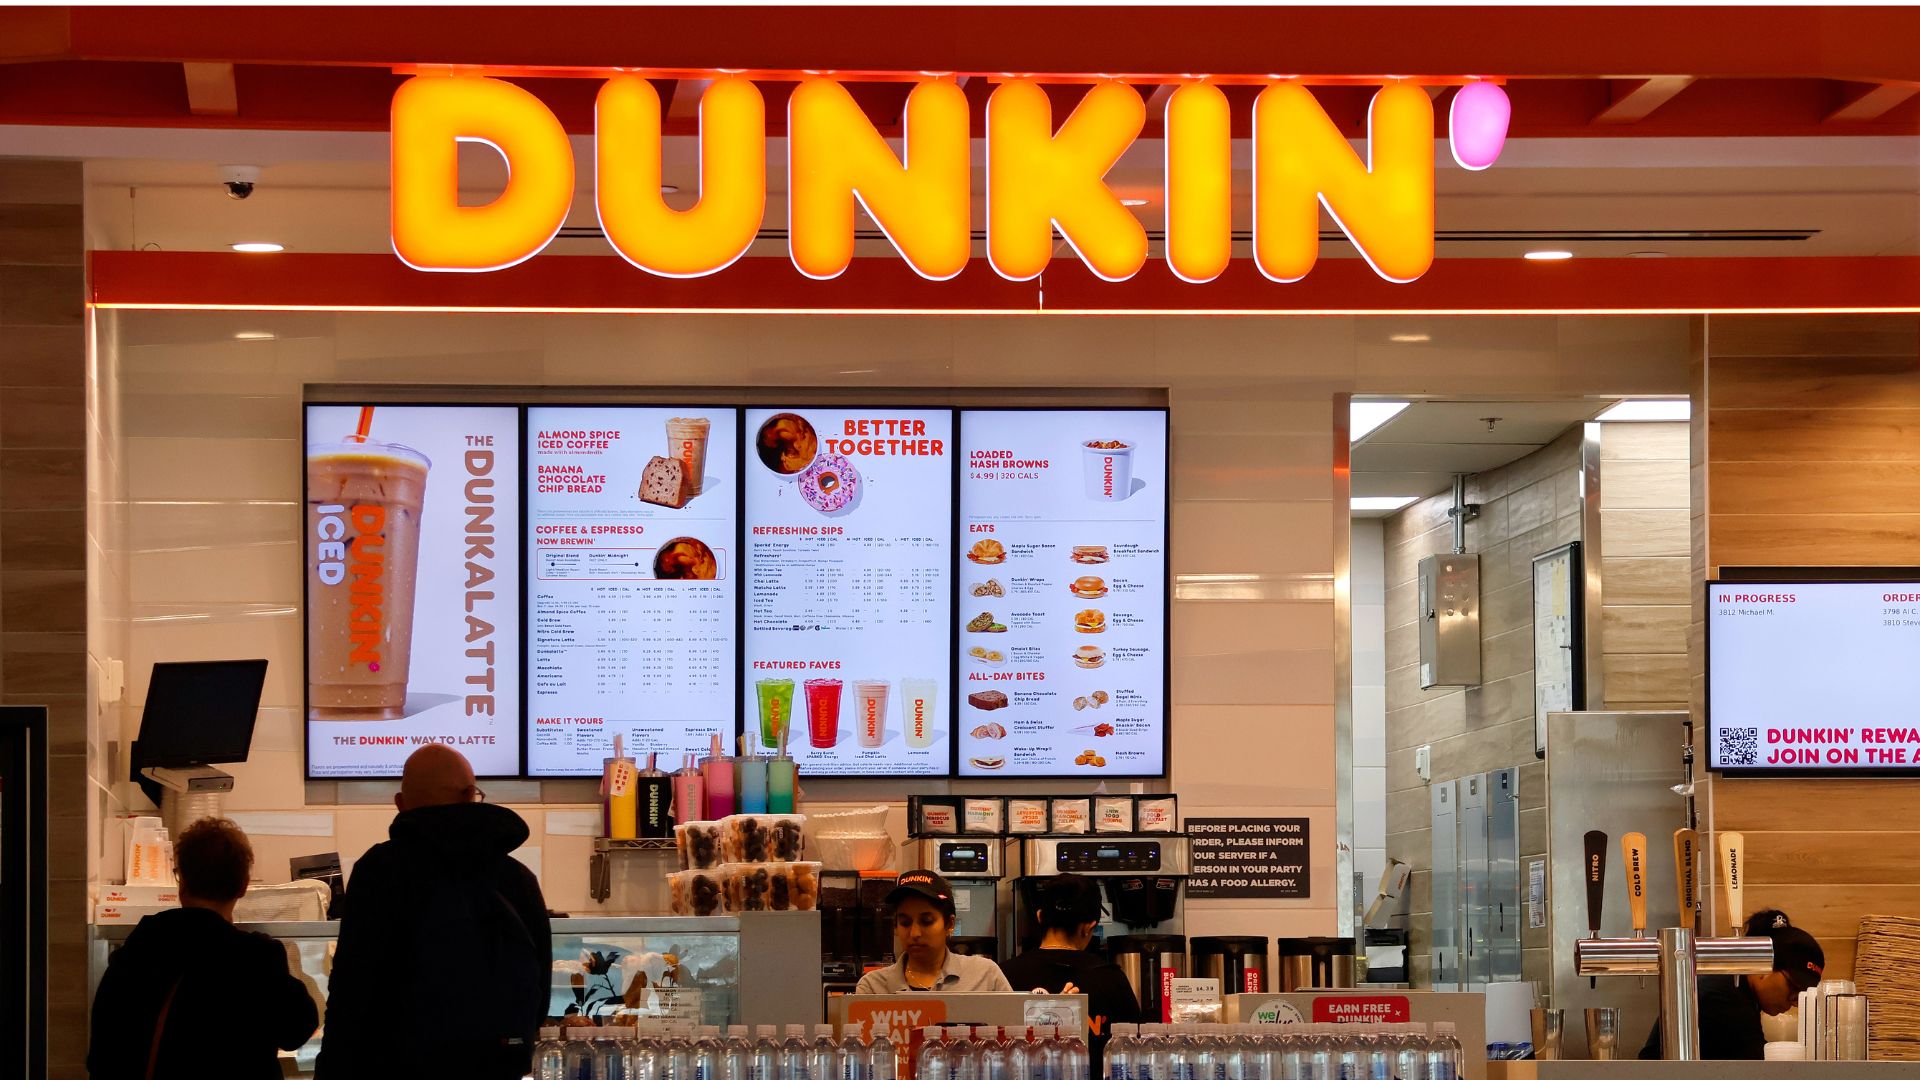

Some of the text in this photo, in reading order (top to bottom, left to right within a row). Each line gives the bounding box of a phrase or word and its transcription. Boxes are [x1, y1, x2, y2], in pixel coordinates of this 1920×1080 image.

[391, 78, 1512, 283] DUNKIN'
[844, 419, 926, 436] BETTER
[537, 431, 621, 439] ALMOND SPICE
[464, 435, 494, 447] THE
[538, 440, 609, 449] ICED COFFEE
[825, 439, 944, 456] TOGETHER
[970, 450, 1013, 459] LOADED
[970, 460, 1049, 469] HASH BROWNS
[538, 466, 584, 474] BANANA
[538, 475, 606, 484] CHOCOLATE
[1001, 472, 1016, 480] 320
[1018, 472, 1039, 480] CALS
[1103, 457, 1113, 499] DUNKIN'
[538, 485, 602, 493] CHIP BREAD
[536, 526, 644, 534] COFFEE & ESPRESSO
[753, 527, 844, 535] REFRESHING SIPS
[970, 525, 995, 533] EATS
[317, 504, 345, 586] ICED
[348, 505, 385, 672] DUNKIN'
[1719, 594, 1796, 603] IN PROGRESS
[753, 661, 841, 669] FEATURED FAVES
[969, 672, 1045, 681] ALL-DAY BITES
[536, 717, 604, 725] MAKE IT YOURS
[867, 699, 876, 738] DUNKIN'
[915, 699, 924, 738] DUNKIN'
[333, 736, 496, 745] THE DUNKIN' WAY TO LATTE
[1767, 728, 1854, 744] DUNKIN'
[1767, 748, 1820, 764] JOIN
[1827, 748, 1859, 764] ON
[1865, 748, 1906, 764] THE
[649, 784, 658, 829] DUNKIN'
[1188, 825, 1300, 833] BEFORE PLACING YOUR
[1226, 838, 1264, 846] PLEASE
[1266, 838, 1304, 846] INFORM
[1193, 852, 1277, 860] OUR SERVER IF A
[1632, 848, 1640, 872] BREW
[1729, 848, 1738, 889] LEMONADE
[900, 875, 934, 886] DUNKIN'
[1188, 879, 1296, 887] HAS A FOOD ALLERGY.
[1328, 1004, 1391, 1013] EARN FREE
[870, 1010, 922, 1026] WHY
[1258, 1011, 1275, 1020] we
[1337, 1014, 1386, 1024] DUNKIN'
